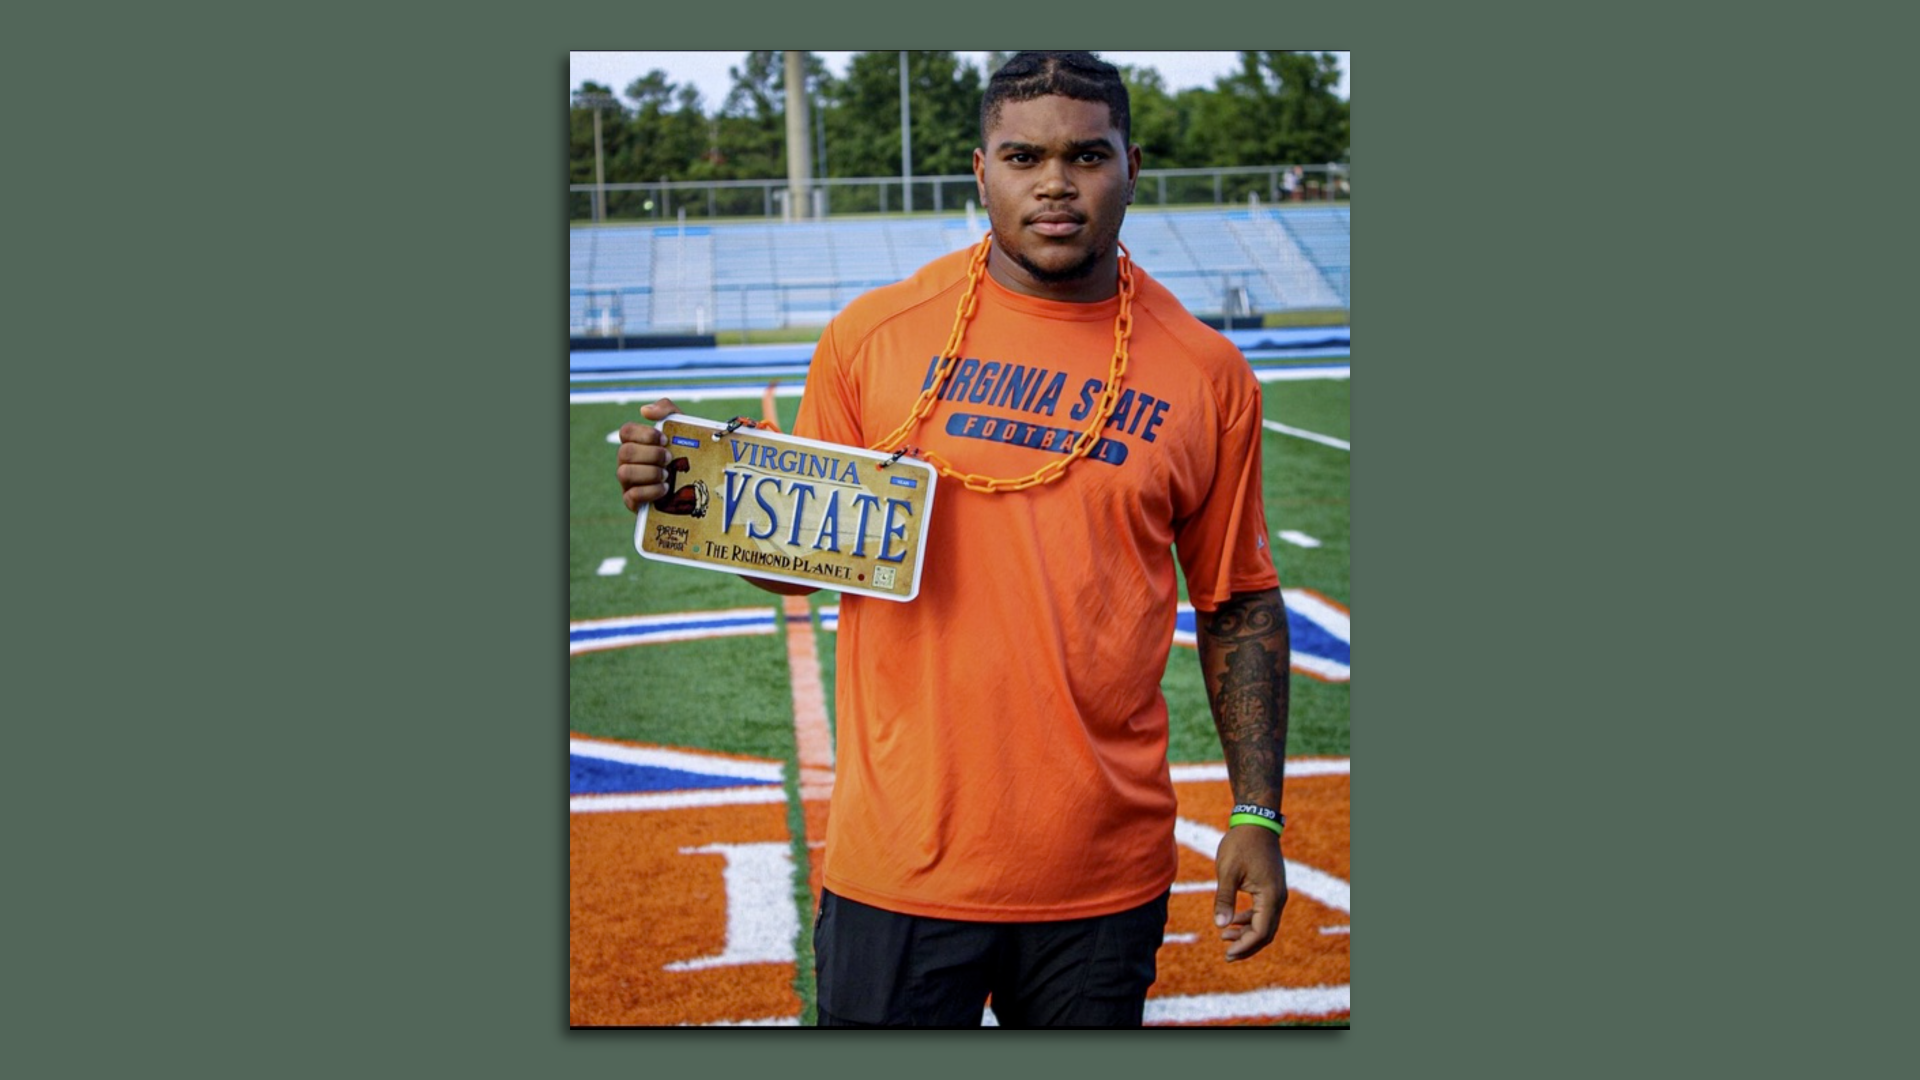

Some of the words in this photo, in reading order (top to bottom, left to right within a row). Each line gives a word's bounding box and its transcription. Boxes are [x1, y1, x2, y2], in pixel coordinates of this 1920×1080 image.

[921, 356, 1067, 416] VIRGINIA
[1070, 378, 1170, 443] SATE
[730, 440, 861, 485] VIRGINIA
[722, 469, 913, 562] VSTATE
[705, 541, 729, 560] THE
[1258, 807, 1276, 819] GET
